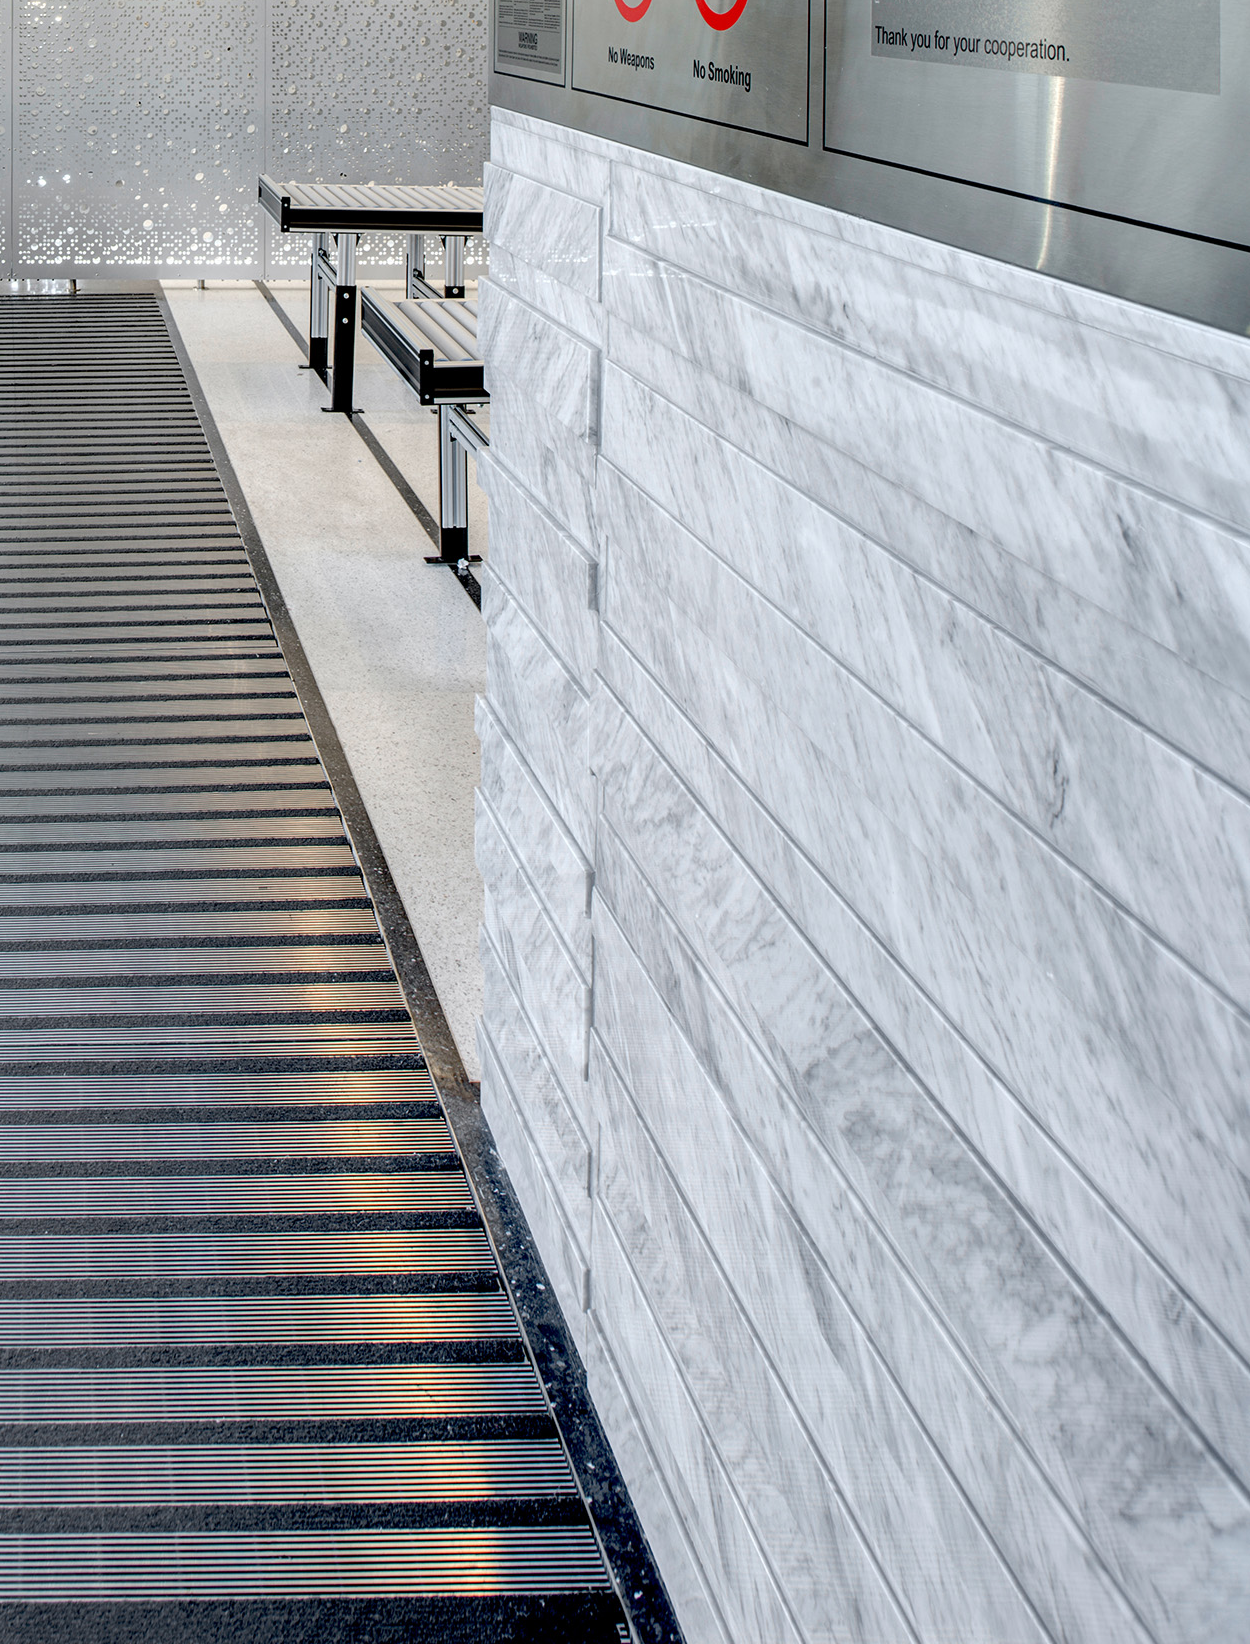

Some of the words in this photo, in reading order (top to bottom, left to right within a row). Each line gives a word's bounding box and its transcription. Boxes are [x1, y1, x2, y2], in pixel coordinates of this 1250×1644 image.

[518, 31, 538, 45] WARNING
[875, 25, 908, 46] Thank
[910, 33, 931, 52] you
[934, 30, 950, 50] for
[953, 37, 981, 56] your
[984, 39, 1069, 61] cooperation.
[608, 46, 619, 64] No
[620, 48, 654, 71] Weapons
[693, 59, 706, 79] No
[708, 62, 751, 92] Smoking
